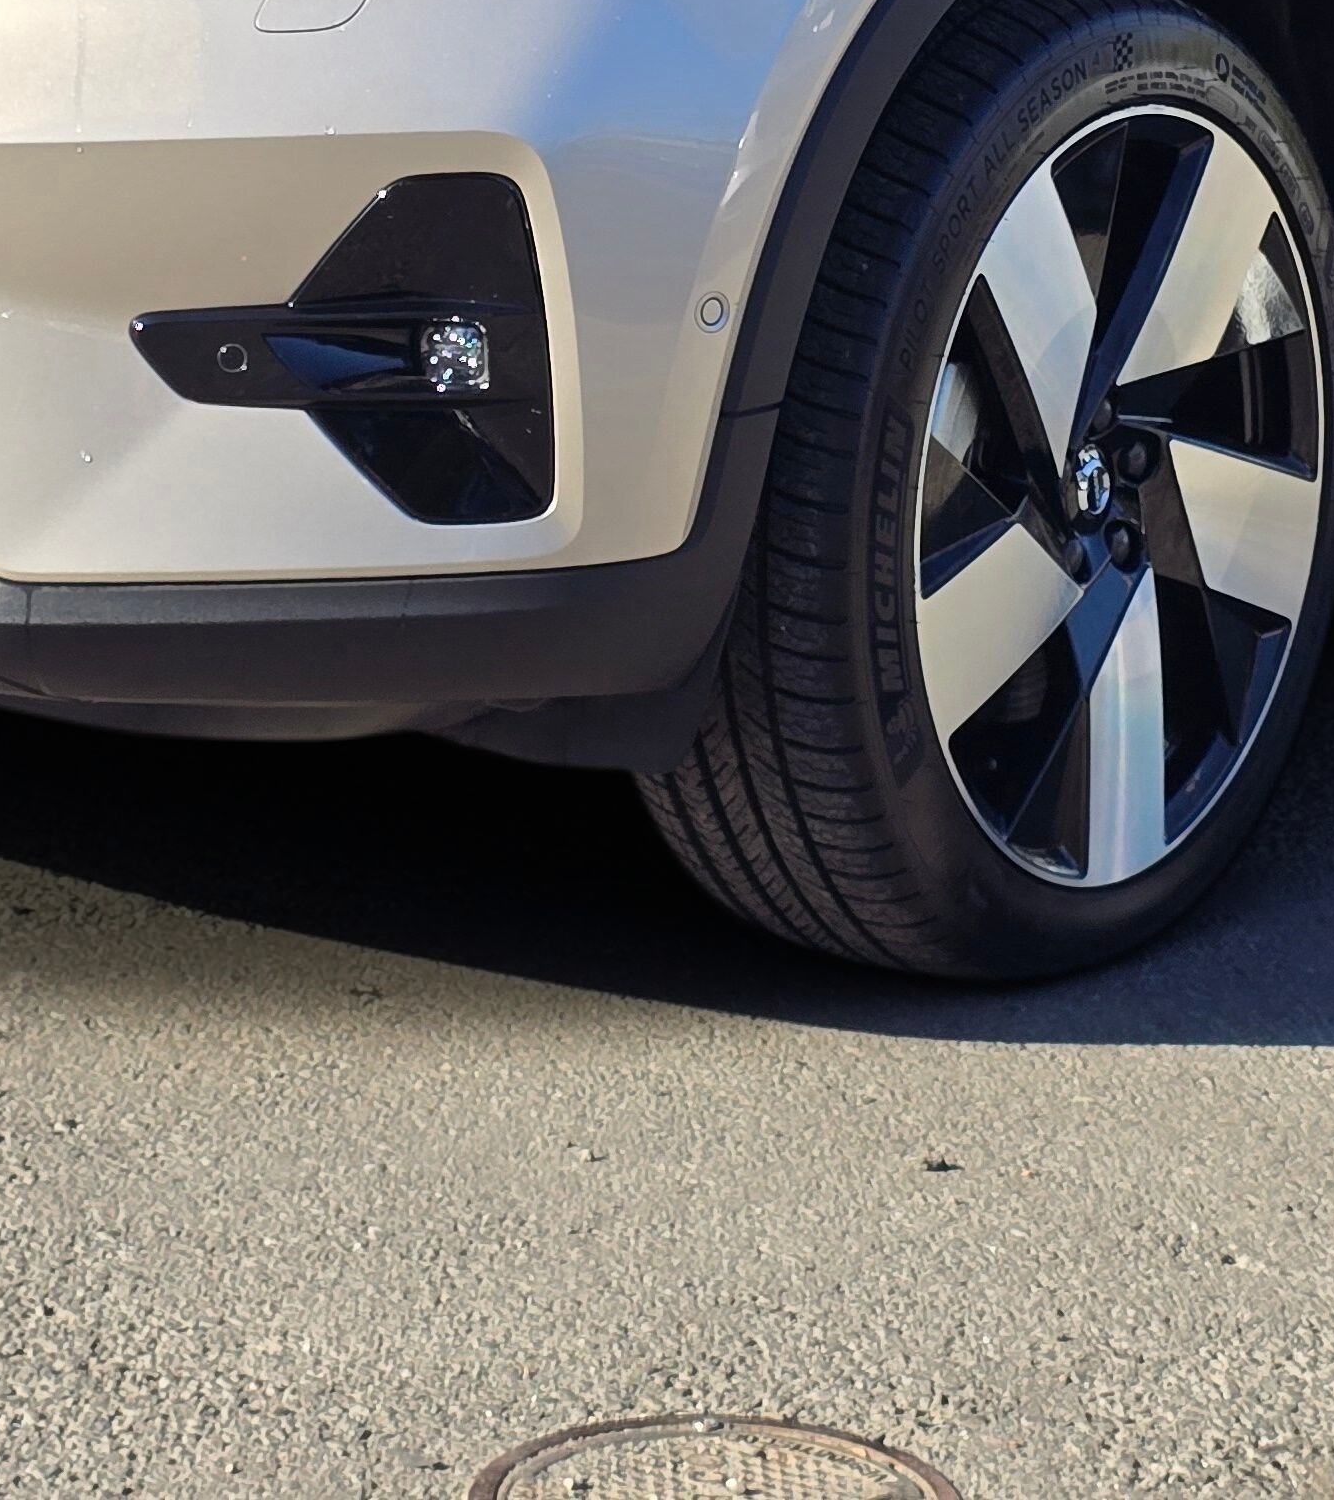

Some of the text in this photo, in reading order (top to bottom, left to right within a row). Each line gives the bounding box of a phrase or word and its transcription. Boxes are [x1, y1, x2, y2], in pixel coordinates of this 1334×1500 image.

[933, 180, 980, 274] SPORT
[984, 131, 1015, 176] ALL
[1018, 59, 1087, 131] SEASON
[874, 413, 906, 691] MICHELIN
